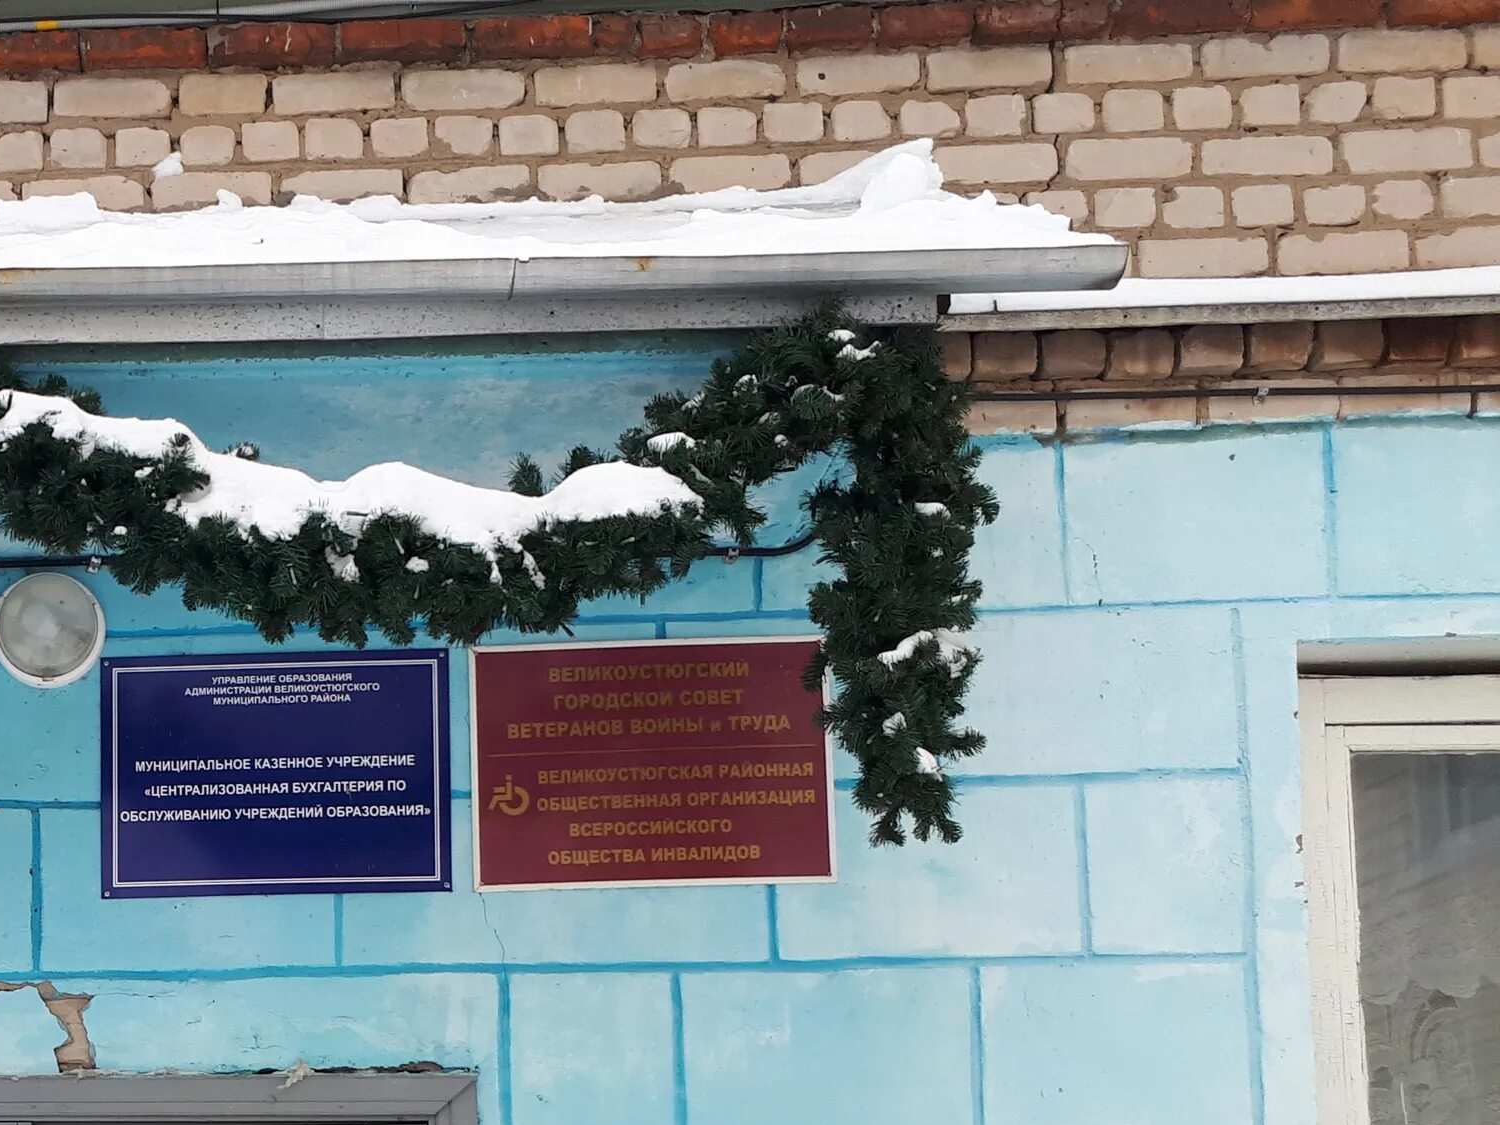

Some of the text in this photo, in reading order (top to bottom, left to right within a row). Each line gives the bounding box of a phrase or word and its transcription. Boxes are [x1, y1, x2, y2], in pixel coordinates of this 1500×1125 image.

[212, 673, 352, 685] УПРАВЛЕНИЕ ОБРАЗОВАНИЯ
[549, 658, 749, 683] ВЕЛИКОУСТЮГСКИЙ
[185, 683, 380, 696] АДМИНИСТРАЦИИ ВЕЛИКОУСТЮГСКОГО
[213, 693, 351, 706] МУНИЦИПАЛЬНОГО РАЙОНА
[553, 689, 743, 711] ГОРОДСКОЙ СОВЕТ
[507, 720, 623, 739] ВЕТЕРАНОВ
[631, 714, 702, 735] ВОЙНЫ
[728, 714, 791, 732] ТРУДА
[135, 755, 415, 772] МУНИЦИПАЛЬНОЕ КАЗЕННОЕ УЧРЕЖДЕНИЕ
[538, 760, 814, 784] ВЕЛИКОУСТЮГСКАЯ РАЙОННАЯ
[144, 780, 406, 797] «ЦЕНТРАЛИЗОВАННАЯ БУХГАЛТЕРИЯ ПО
[537, 789, 815, 812] ОБЩЕСТВЕННАЯ ОРГАНИЗАЦИЯ
[120, 805, 431, 822] ОБСЛУЖИВАНИЮ УЧРЕЖДЕНИЙ ОБРАЗОВАНИЯ»
[569, 817, 732, 837] ВСЕРОССИЙСКОГО
[548, 845, 760, 866] ОБЩЕСТВА ИНВАЛИДОВ
